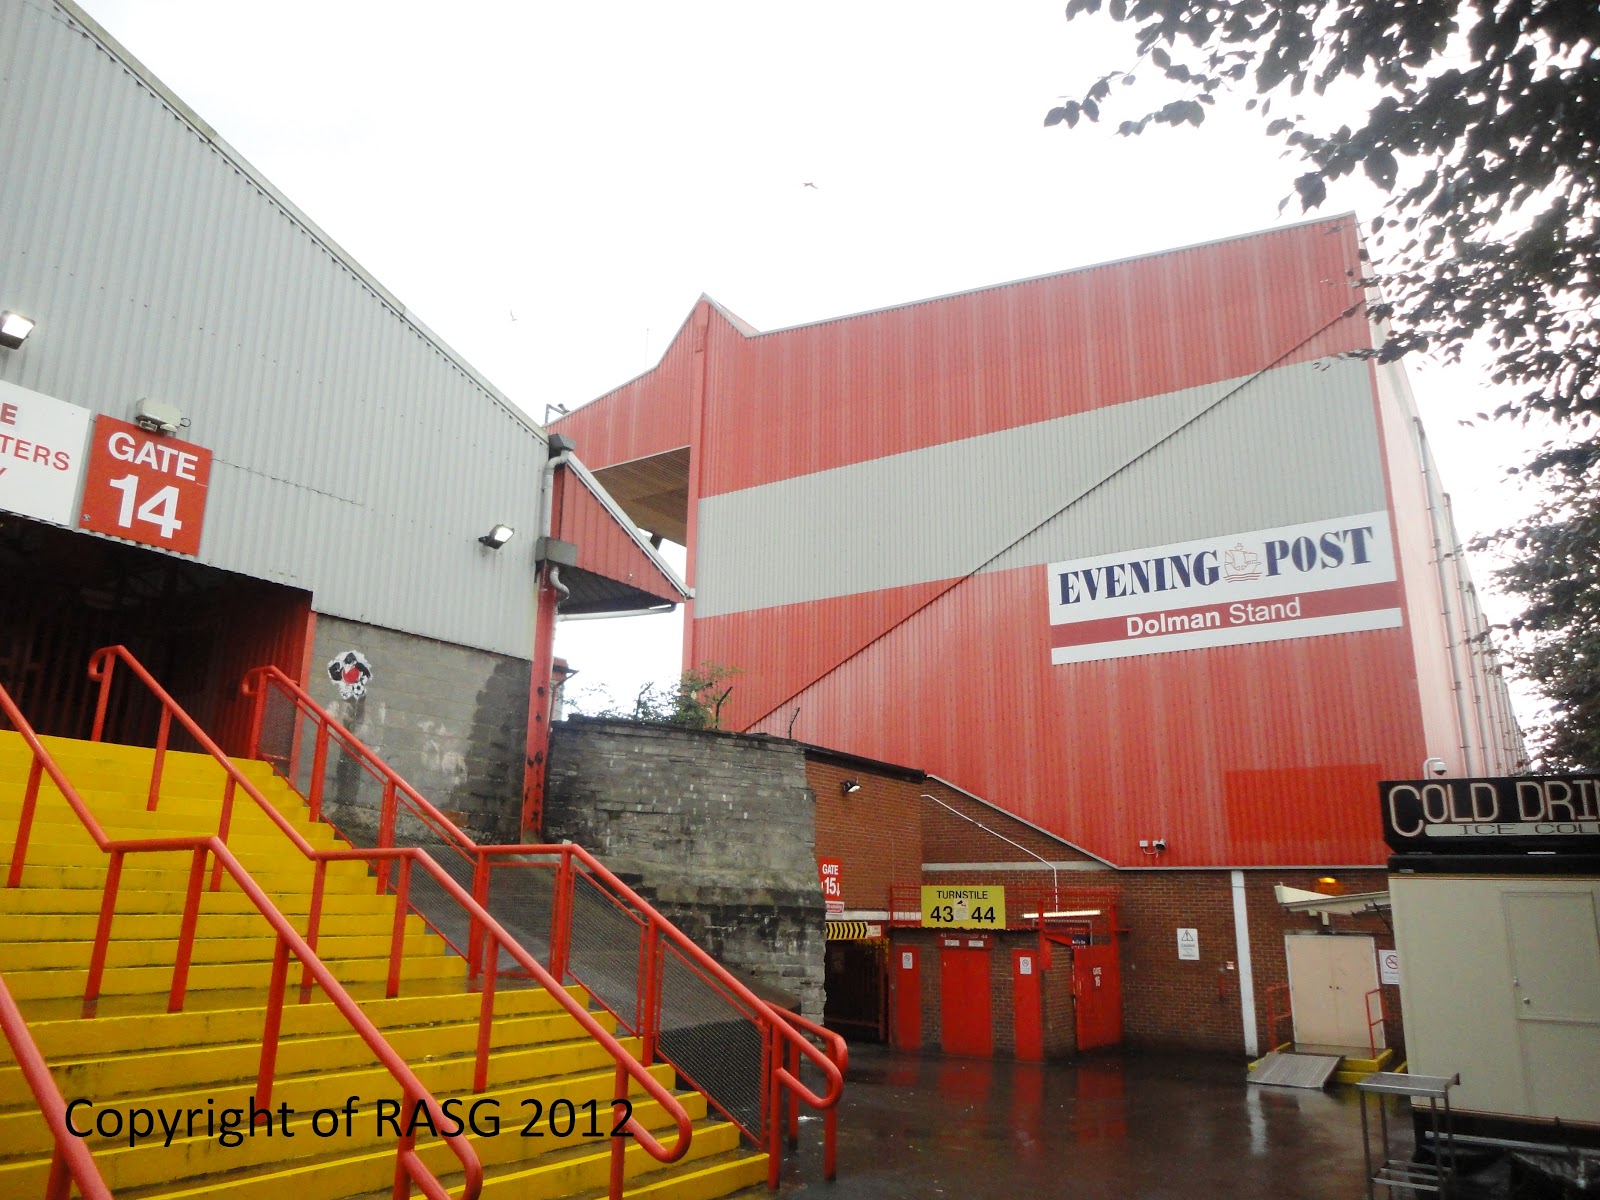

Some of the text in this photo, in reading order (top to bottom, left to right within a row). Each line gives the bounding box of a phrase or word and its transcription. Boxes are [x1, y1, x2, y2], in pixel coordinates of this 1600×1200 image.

[108, 431, 199, 481] GATE
[109, 474, 183, 539] 14
[1058, 526, 1374, 605] EVENING POST
[1126, 597, 1301, 637] Dolman Stand
[1388, 783, 1499, 837] COLD
[1458, 823, 1600, 835] ICE COL
[822, 863, 839, 875] GATE
[824, 877, 837, 895] 15
[936, 890, 989, 900] TURNSTILE
[930, 905, 954, 923] 43
[971, 906, 996, 923] 44
[1092, 966, 1102, 976] GATE
